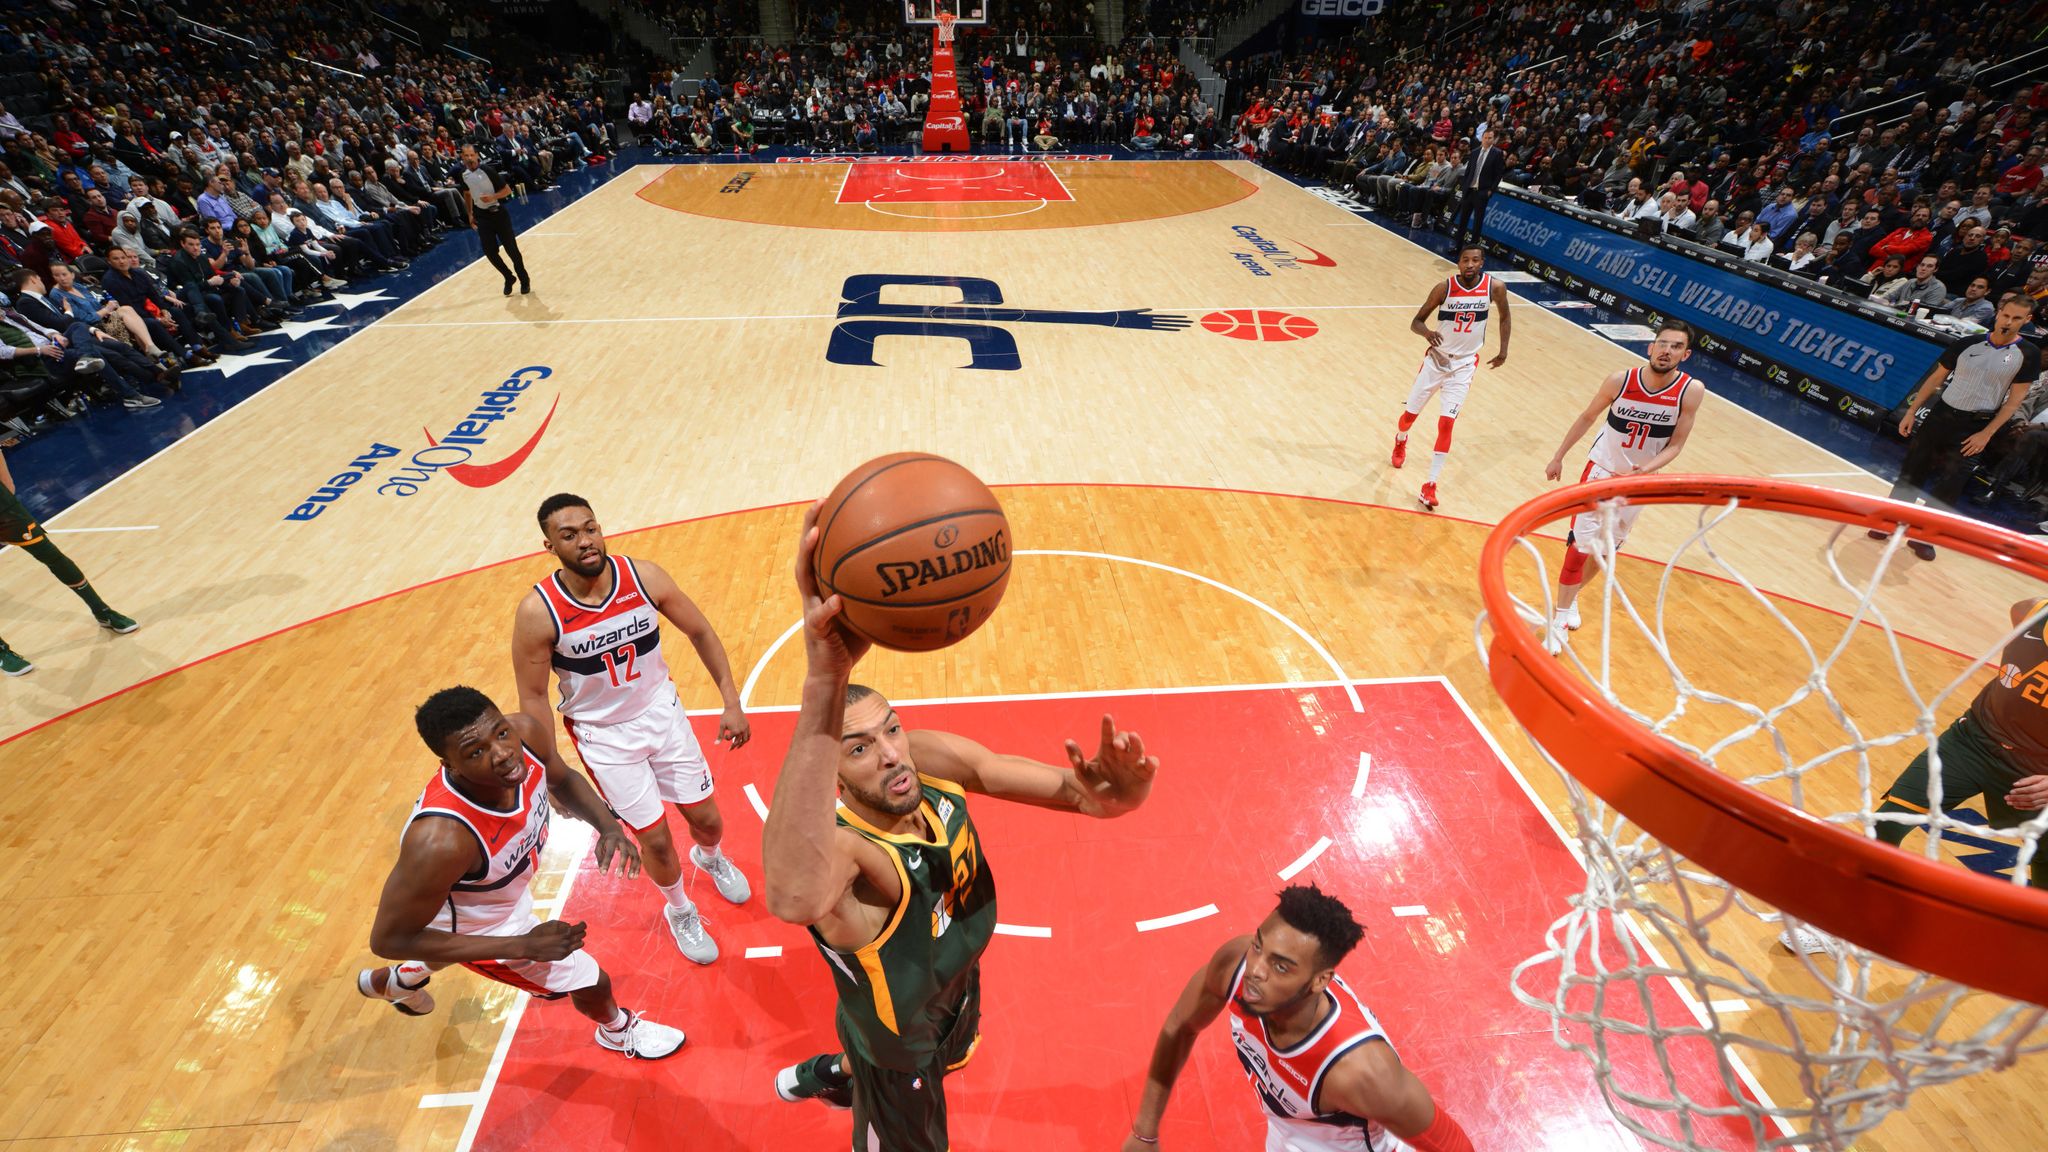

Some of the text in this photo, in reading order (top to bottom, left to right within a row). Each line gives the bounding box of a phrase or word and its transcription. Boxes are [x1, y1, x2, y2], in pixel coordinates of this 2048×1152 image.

[1301, 0, 1383, 16] GEICO
[1230, 252, 1272, 277] Arena
[1484, 201, 1556, 248] ketmaster
[1564, 238, 1602, 265] BUY
[1597, 250, 1637, 280] AND
[1632, 262, 1679, 297] SELL
[1679, 279, 1781, 336] WIZARDS
[1778, 318, 1895, 382] TICKETS
[1588, 287, 1617, 306] WE ARE
[1447, 300, 1487, 310] wizards
[1453, 312, 1477, 334] 52
[1616, 406, 1672, 423] wizards
[1851, 401, 1875, 416] Hampshire
[1621, 421, 1651, 450] 31
[283, 442, 402, 521] Arena
[876, 528, 1007, 598] SPALDING
[615, 591, 638, 604] GEICO
[571, 615, 650, 655] wizards
[600, 642, 642, 688] 12
[1278, 1058, 1309, 1087] GEICO
